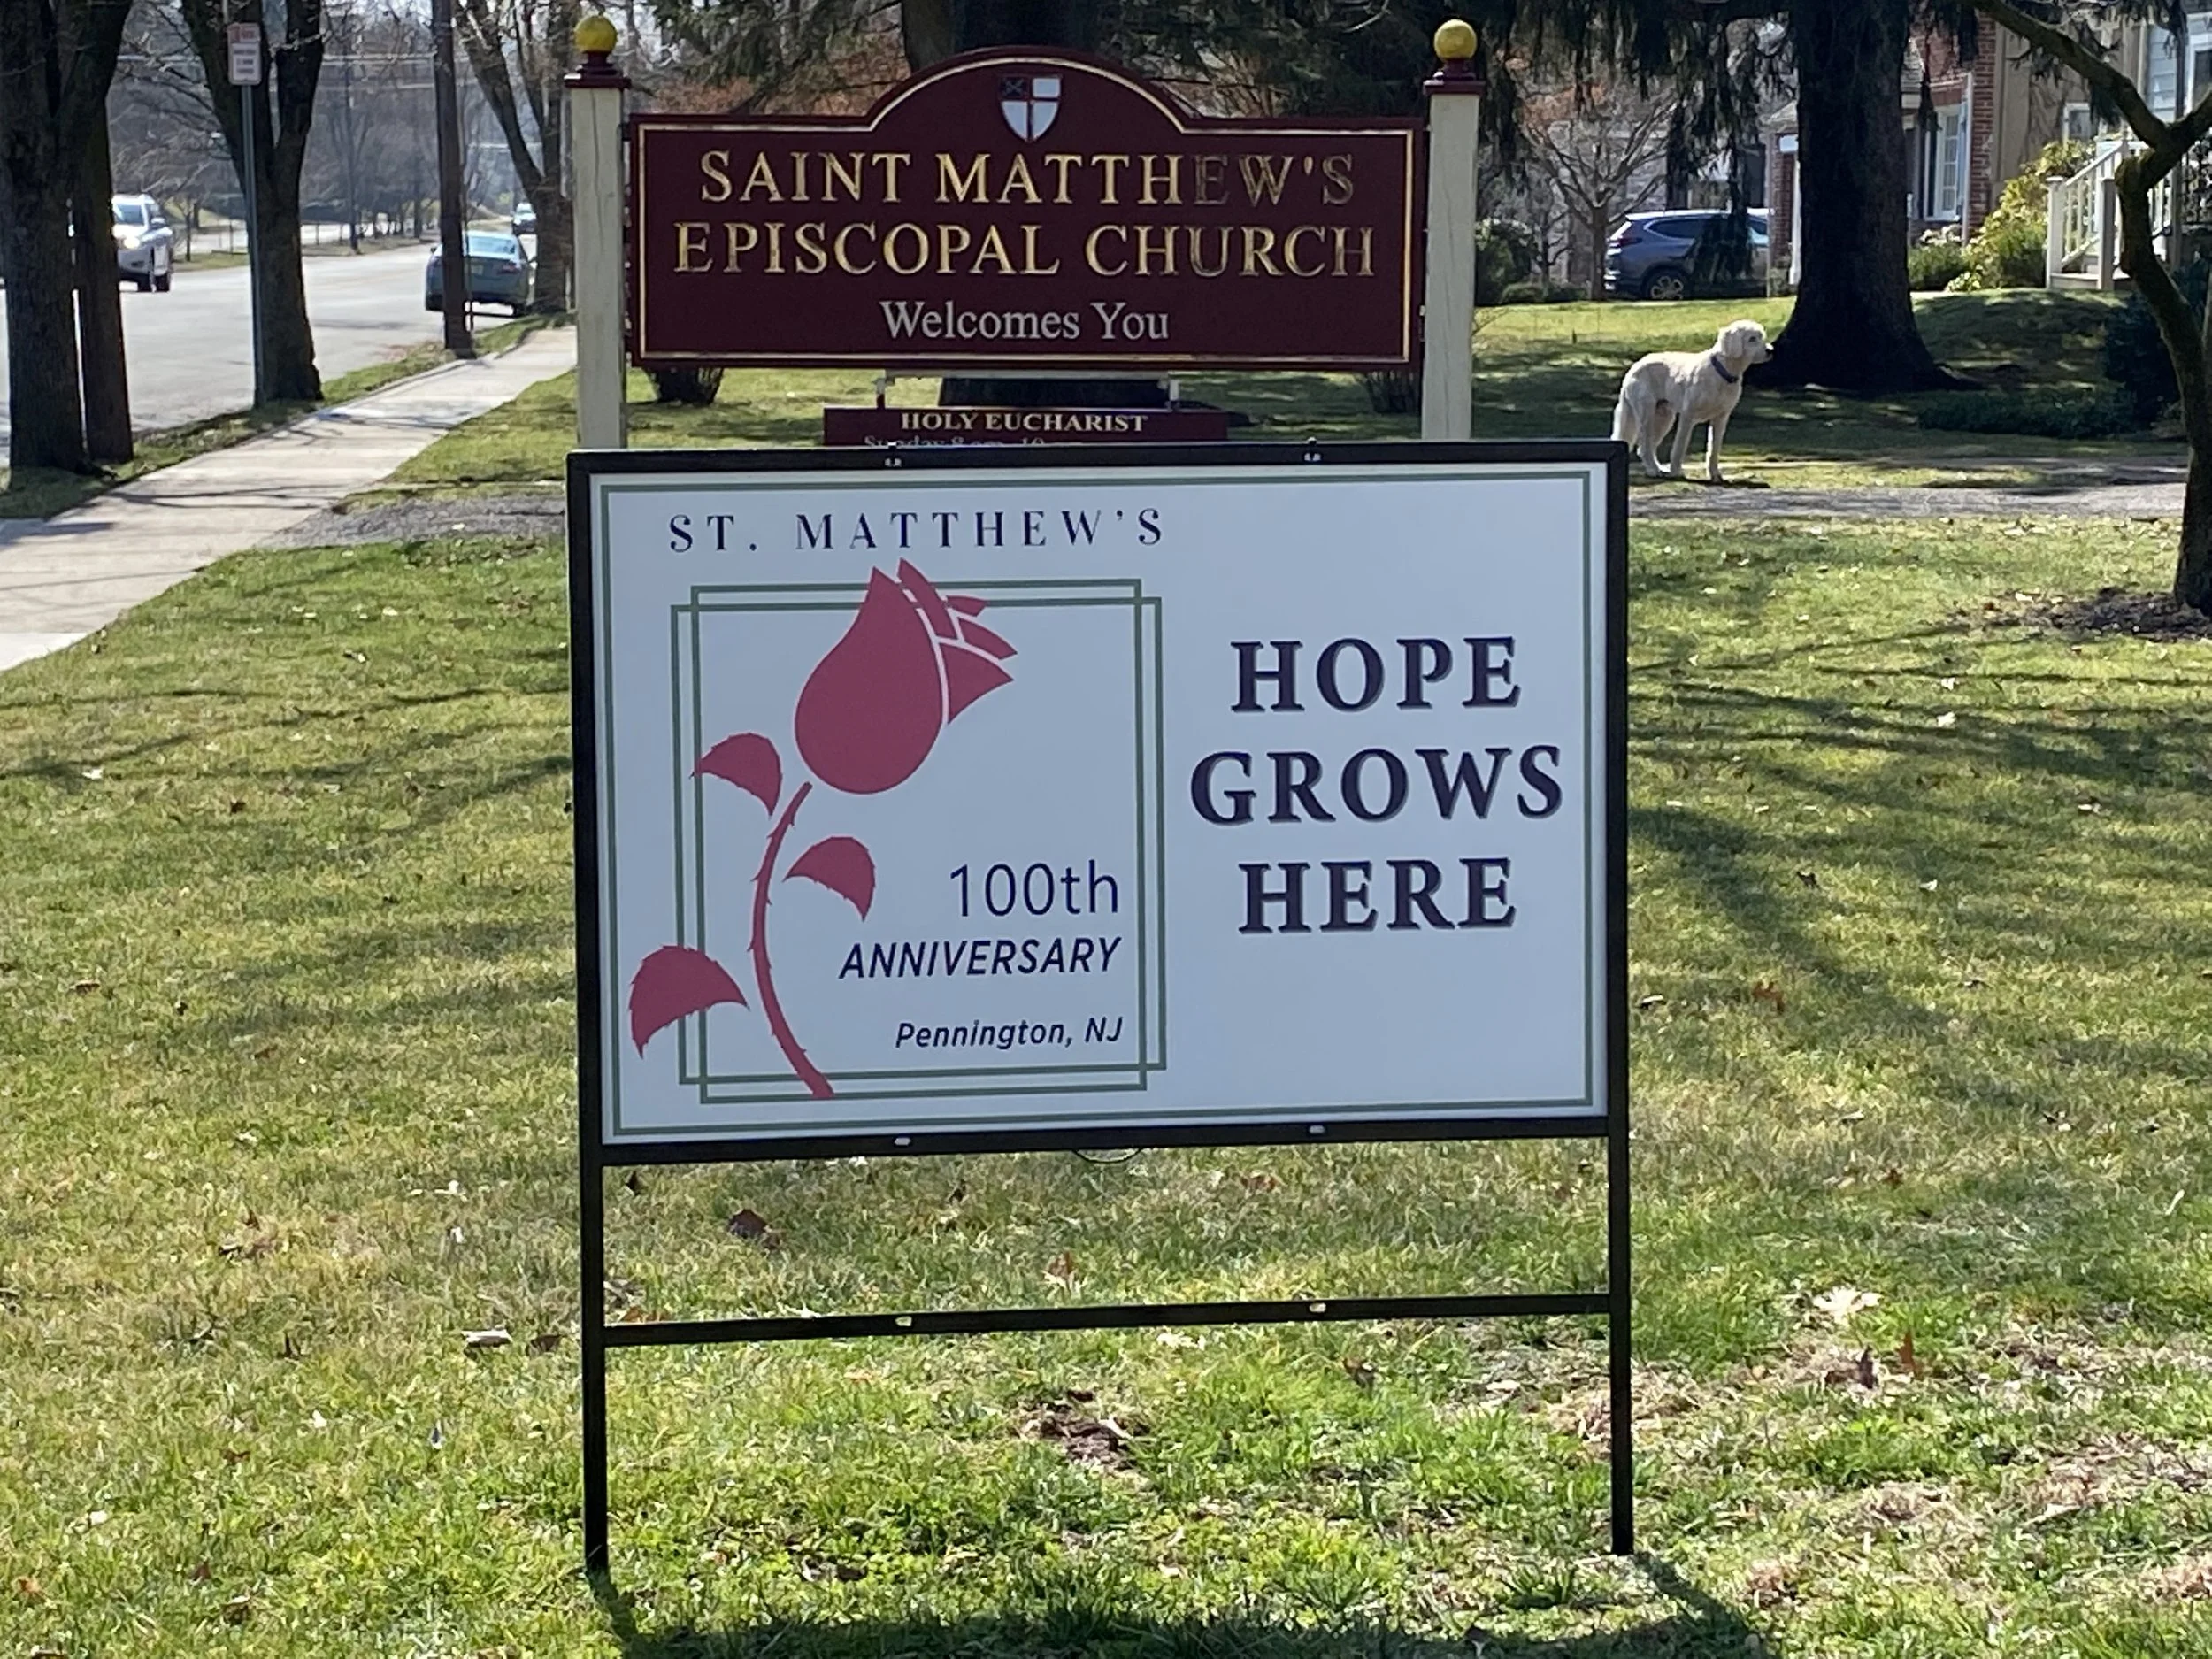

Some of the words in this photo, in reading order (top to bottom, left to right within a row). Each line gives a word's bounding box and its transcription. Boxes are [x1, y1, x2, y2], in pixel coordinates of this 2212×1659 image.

[699, 150, 911, 204] SAINT
[934, 151, 1356, 208] MATTHEW'S
[672, 220, 1060, 276] EPISCOPAL
[1085, 223, 1375, 278] CHURCH
[879, 298, 1080, 342] Welcomes
[1090, 300, 1170, 342] You
[900, 411, 977, 432] HOLY
[985, 412, 1148, 433] EUCHARIST
[669, 513, 758, 554] ST.
[795, 508, 1164, 550] MATTHEW'S
[1230, 635, 1521, 713] HOPE
[1190, 745, 1563, 826] GROWS
[949, 859, 1120, 918] 100th
[1238, 857, 1517, 935] HERE
[838, 936, 1123, 979] ANNIVERSARY
[895, 1018, 1073, 1050] Pennington,
[1084, 1016, 1125, 1043] NJ
